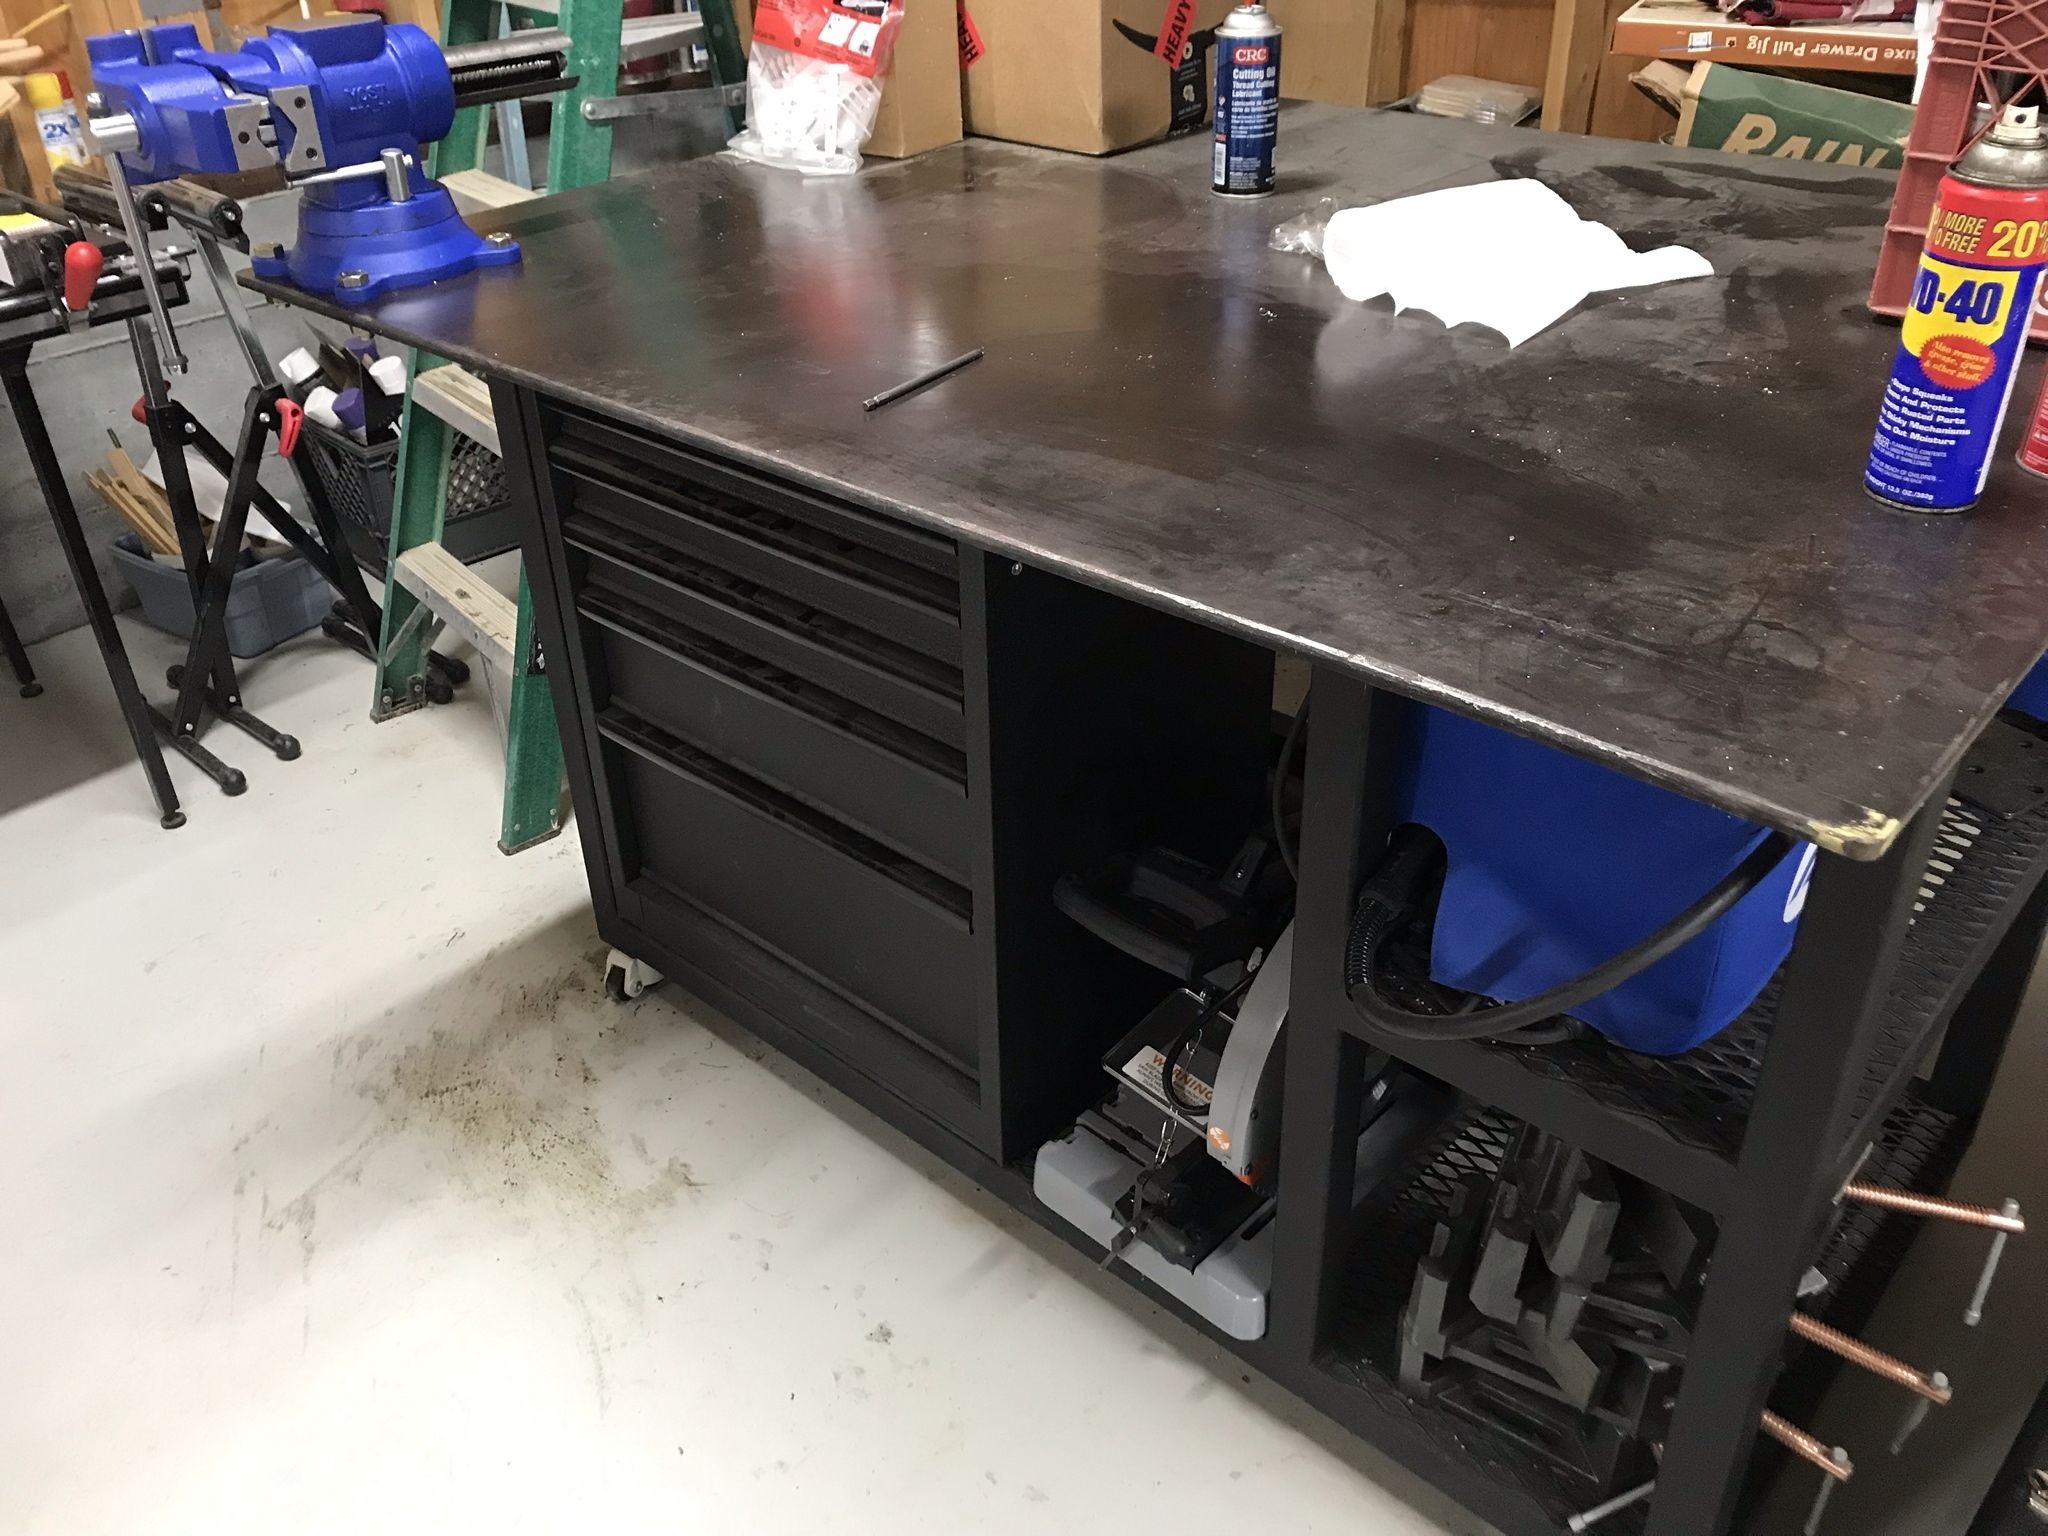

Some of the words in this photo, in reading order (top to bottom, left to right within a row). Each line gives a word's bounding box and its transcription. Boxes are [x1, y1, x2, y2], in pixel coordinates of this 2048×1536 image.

[1163, 0, 1191, 63] HEAVY
[1747, 36, 1771, 55] Jig
[1773, 41, 1807, 57] Pull
[1811, 43, 1878, 62] Drawer
[1884, 47, 1917, 60] uxe
[1236, 48, 1267, 62] CRC
[1233, 68, 1264, 80] Cutting
[44, 124, 69, 138] 2X
[1943, 211, 1987, 236] MORE
[1942, 232, 1980, 254] FREE
[1912, 387, 1954, 402] Squeaks
[1901, 396, 1918, 407] And
[1920, 401, 1965, 414] Protects
[1901, 406, 1933, 421] Rusted
[1936, 415, 1966, 425] Parts
[1893, 426, 1907, 437] Out
[1909, 432, 1956, 445] Moisture
[1909, 420, 1970, 435] Mechanisms
[1153, 1054, 1213, 1100] WRNING
